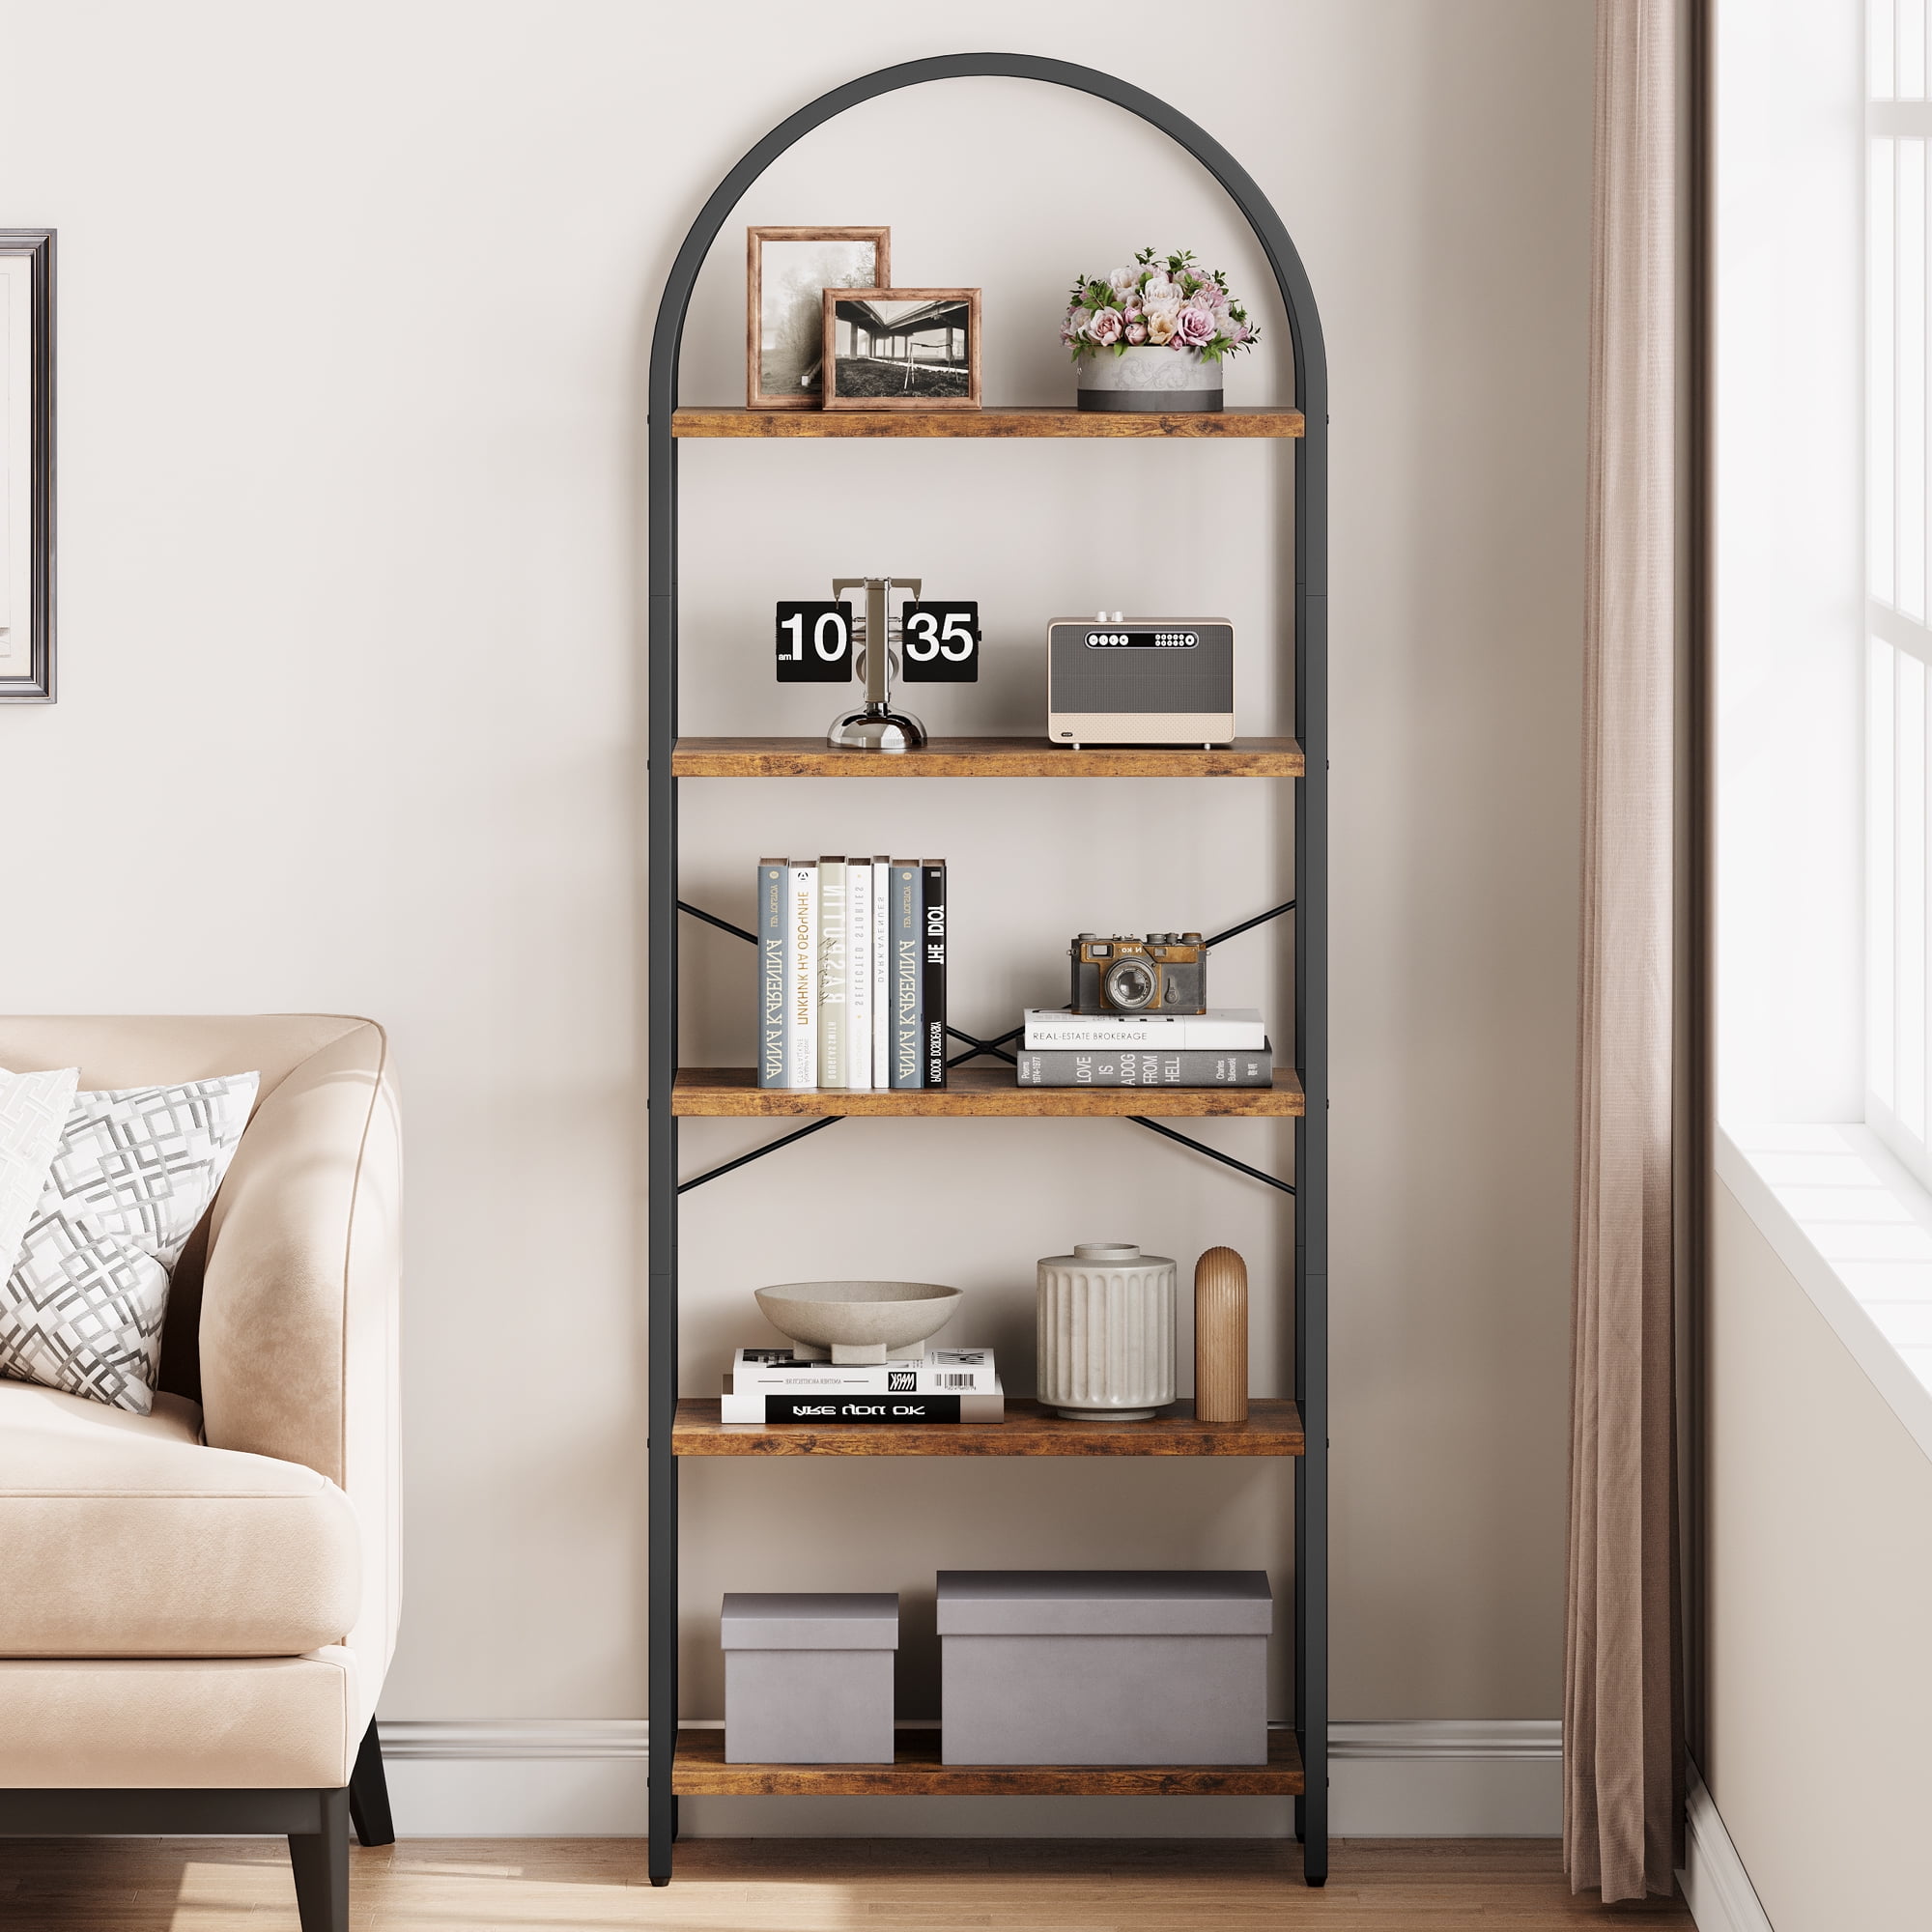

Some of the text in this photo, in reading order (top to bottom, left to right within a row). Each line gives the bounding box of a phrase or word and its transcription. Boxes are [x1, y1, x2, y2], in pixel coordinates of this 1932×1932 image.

[781, 611, 847, 662] 10
[906, 611, 974, 662] 35
[1033, 1032, 1147, 1040] REAL-ESTATE BROKERAGE
[1021, 1061, 1030, 1079] Poems
[1076, 1056, 1092, 1083] LOVE
[1098, 1065, 1114, 1075] IS
[1121, 1053, 1136, 1086] A DOG
[1143, 1055, 1158, 1084] FROM
[1165, 1057, 1180, 1083] HELL
[1215, 1060, 1225, 1080] Charles
[1227, 1058, 1236, 1081] Bukowski
